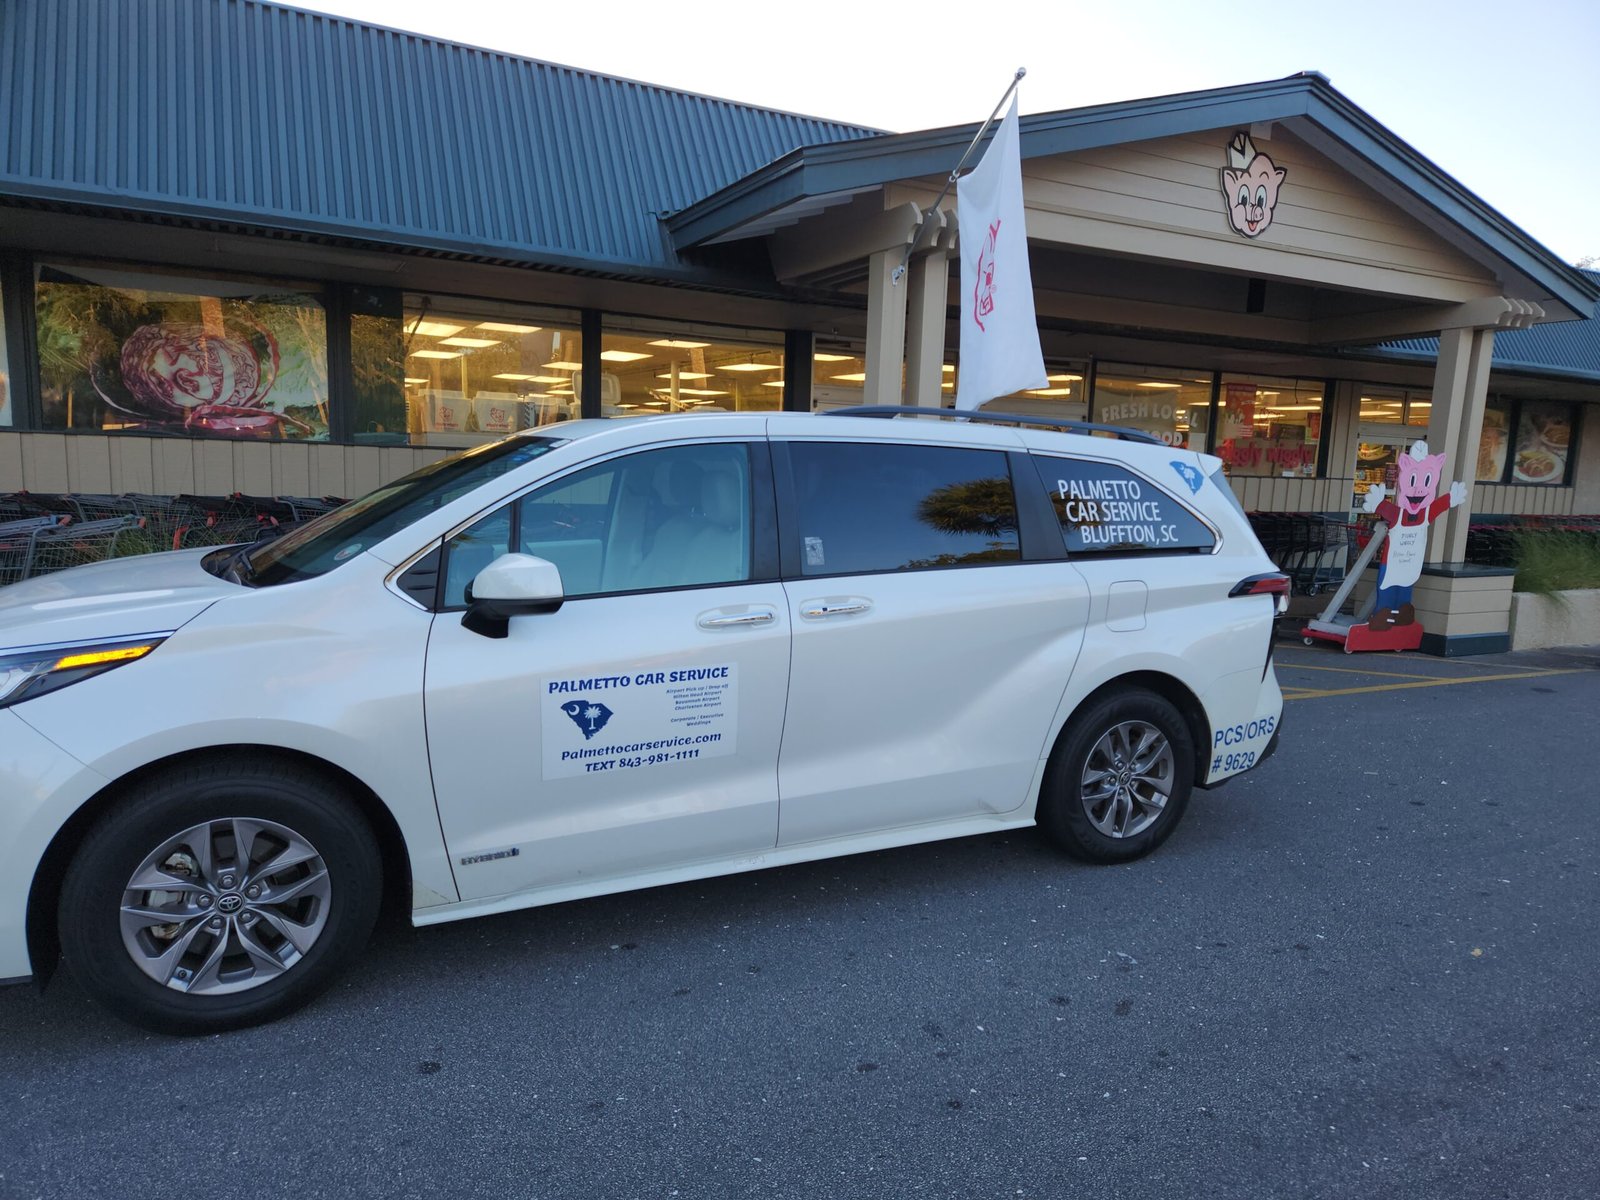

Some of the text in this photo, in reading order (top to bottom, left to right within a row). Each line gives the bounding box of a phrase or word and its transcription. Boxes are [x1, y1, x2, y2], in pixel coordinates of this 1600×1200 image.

[1101, 403, 1199, 428] FRESH LOCAL
[1057, 479, 1141, 500] PALMETTO
[1066, 501, 1162, 522] CAR SERVICE
[1081, 524, 1179, 545] BLUFFTON, SC
[548, 666, 729, 694] PALMETTO CAR SERVICE
[1213, 715, 1275, 749] PCS/ORS
[561, 732, 722, 761] Palmettocarservice.com
[585, 748, 700, 773] TEXT 843-981-1111
[1211, 751, 1255, 773] # 9629
